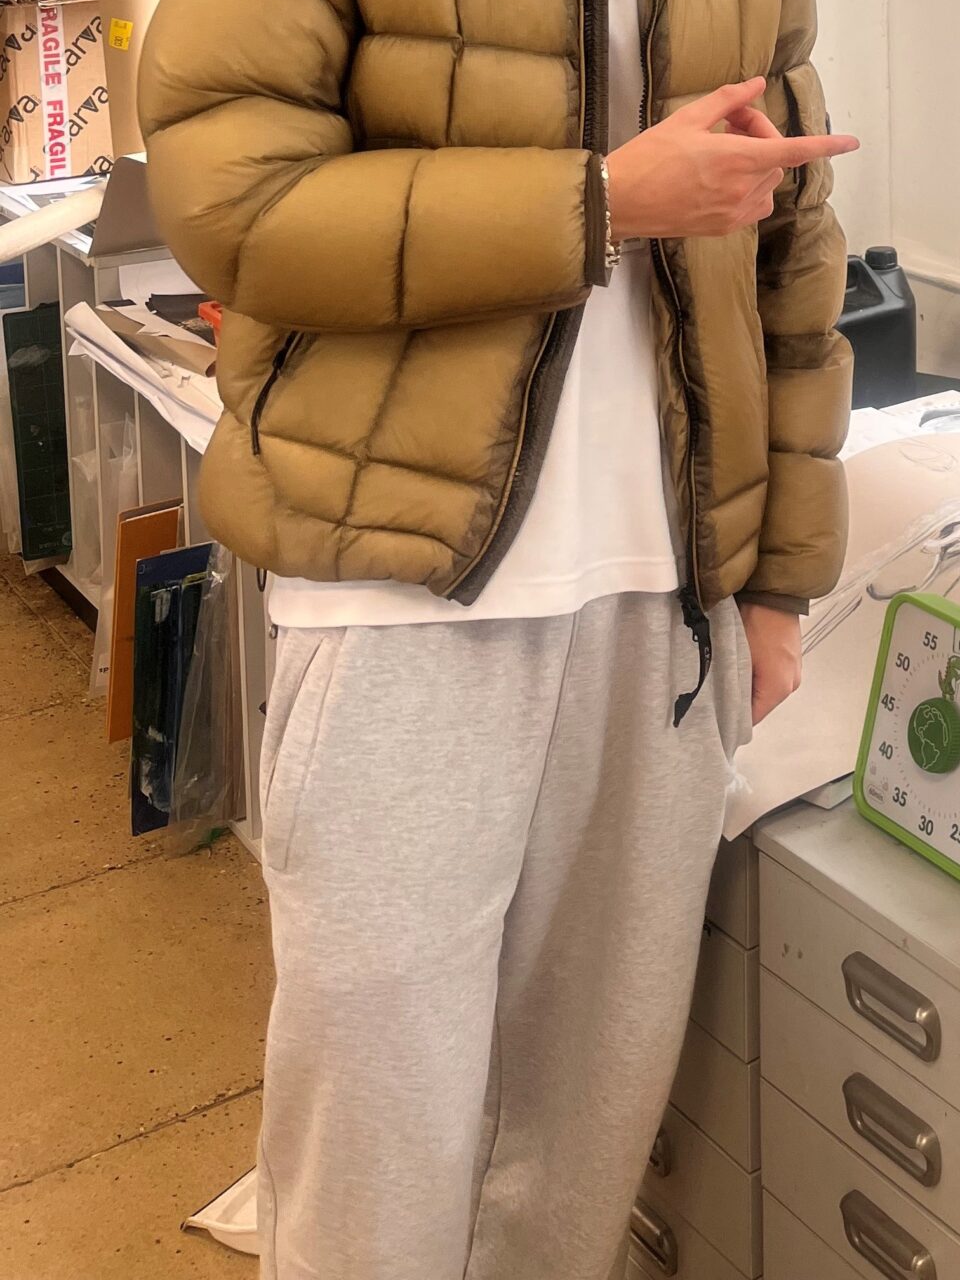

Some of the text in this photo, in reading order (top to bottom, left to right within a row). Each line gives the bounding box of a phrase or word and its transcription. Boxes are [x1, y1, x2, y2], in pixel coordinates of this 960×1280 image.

[40, 7, 67, 177] RAGILE FRAGIL
[922, 631, 939, 651] 55
[895, 652, 911, 672] 50
[881, 692, 896, 712] 45
[878, 741, 894, 760] 40
[892, 786, 908, 808] 35
[918, 815, 934, 836] 30
